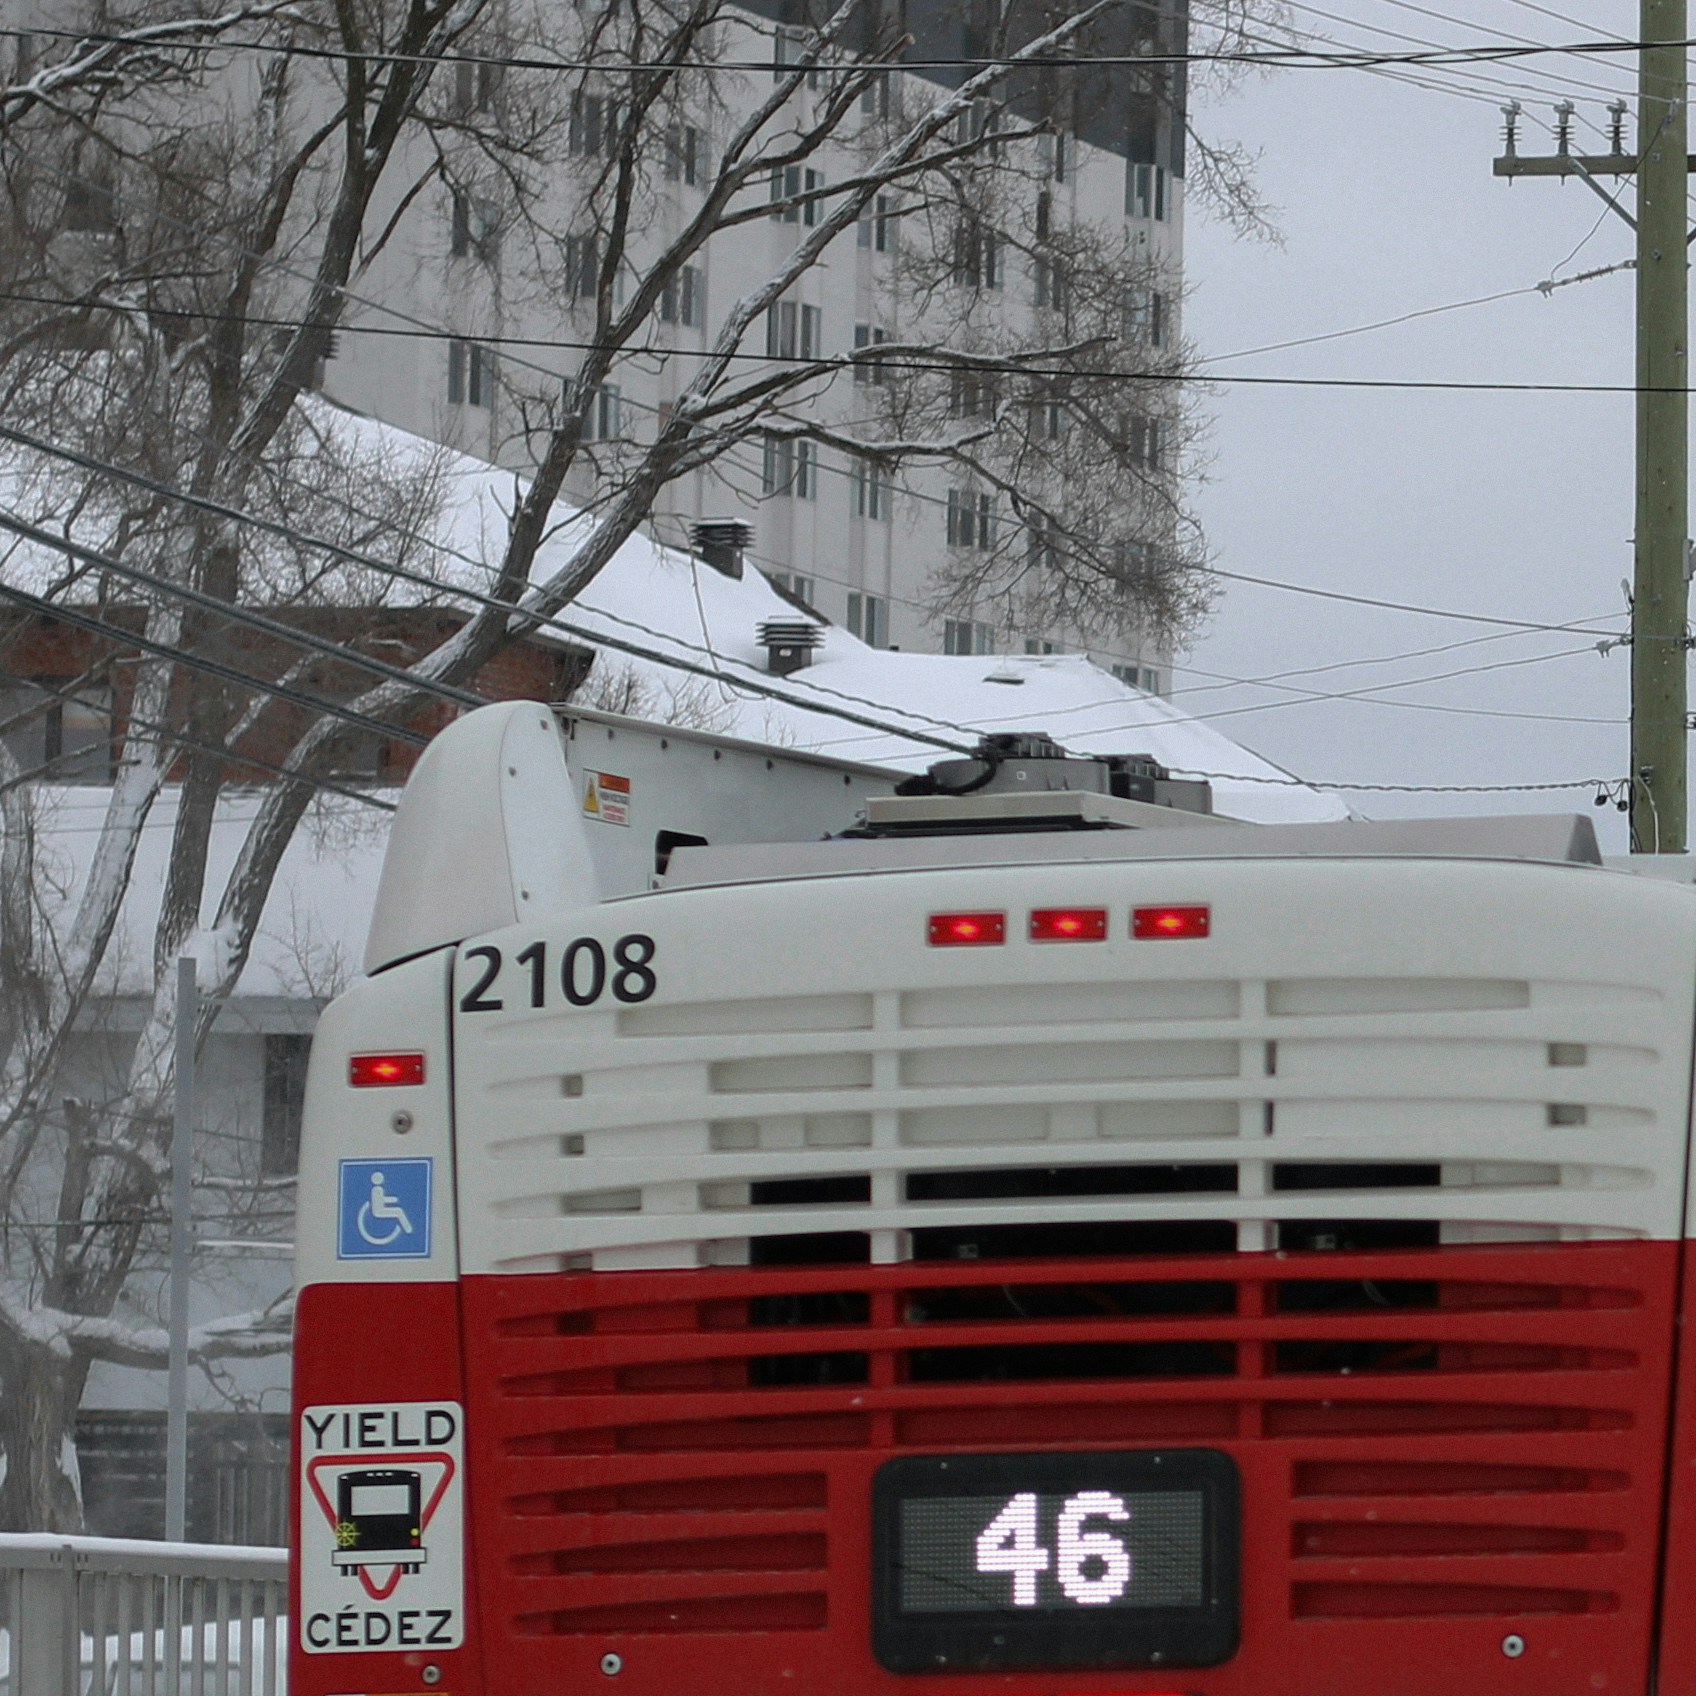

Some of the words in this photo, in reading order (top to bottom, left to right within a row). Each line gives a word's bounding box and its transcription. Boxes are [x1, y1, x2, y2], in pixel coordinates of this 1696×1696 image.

[460, 933, 656, 1012] 2108
[304, 1410, 456, 1449] YIELD
[977, 1491, 1130, 1605] 46
[306, 1605, 452, 1648] CÉDEZ
